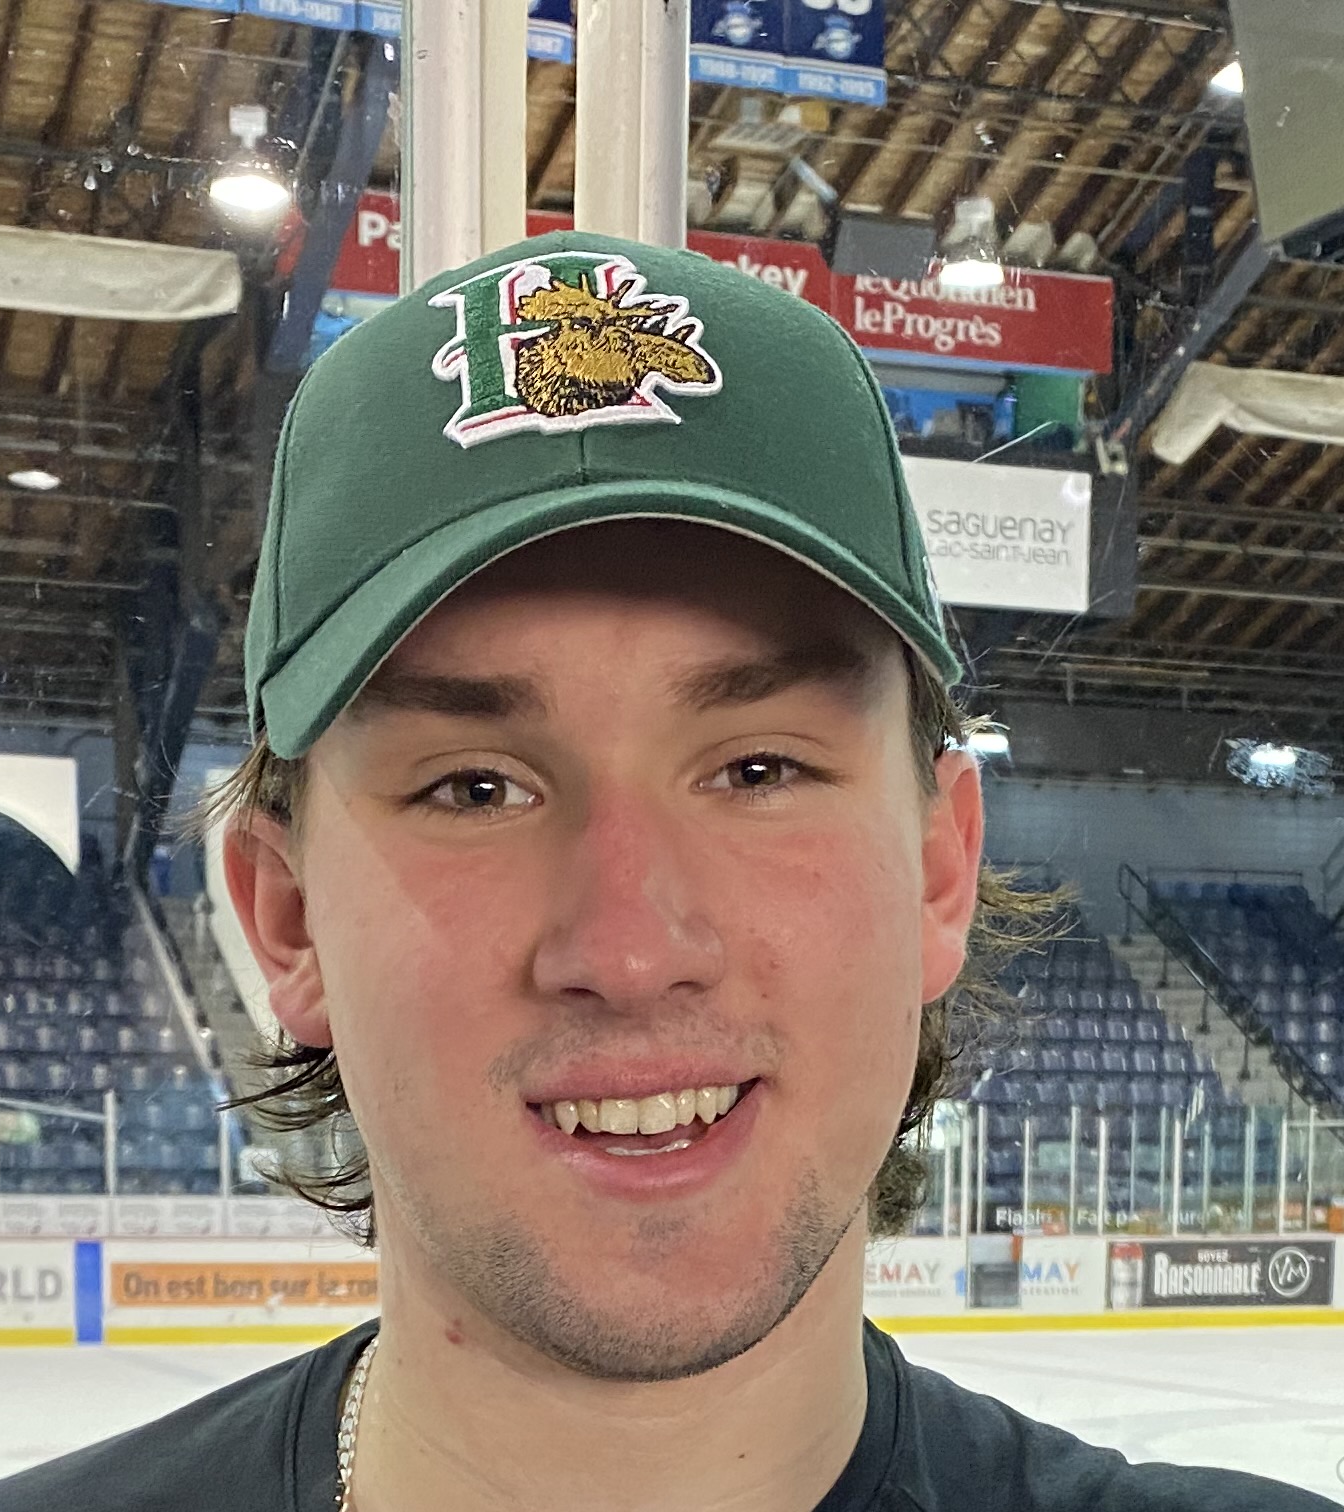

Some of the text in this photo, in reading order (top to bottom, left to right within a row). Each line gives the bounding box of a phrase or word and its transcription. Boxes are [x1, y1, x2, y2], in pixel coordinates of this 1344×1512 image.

[123, 1271, 161, 1298] On
[166, 1275, 206, 1298] est
[212, 1271, 264, 1298] bon
[1154, 1252, 1265, 1297] RAISONNABLE
